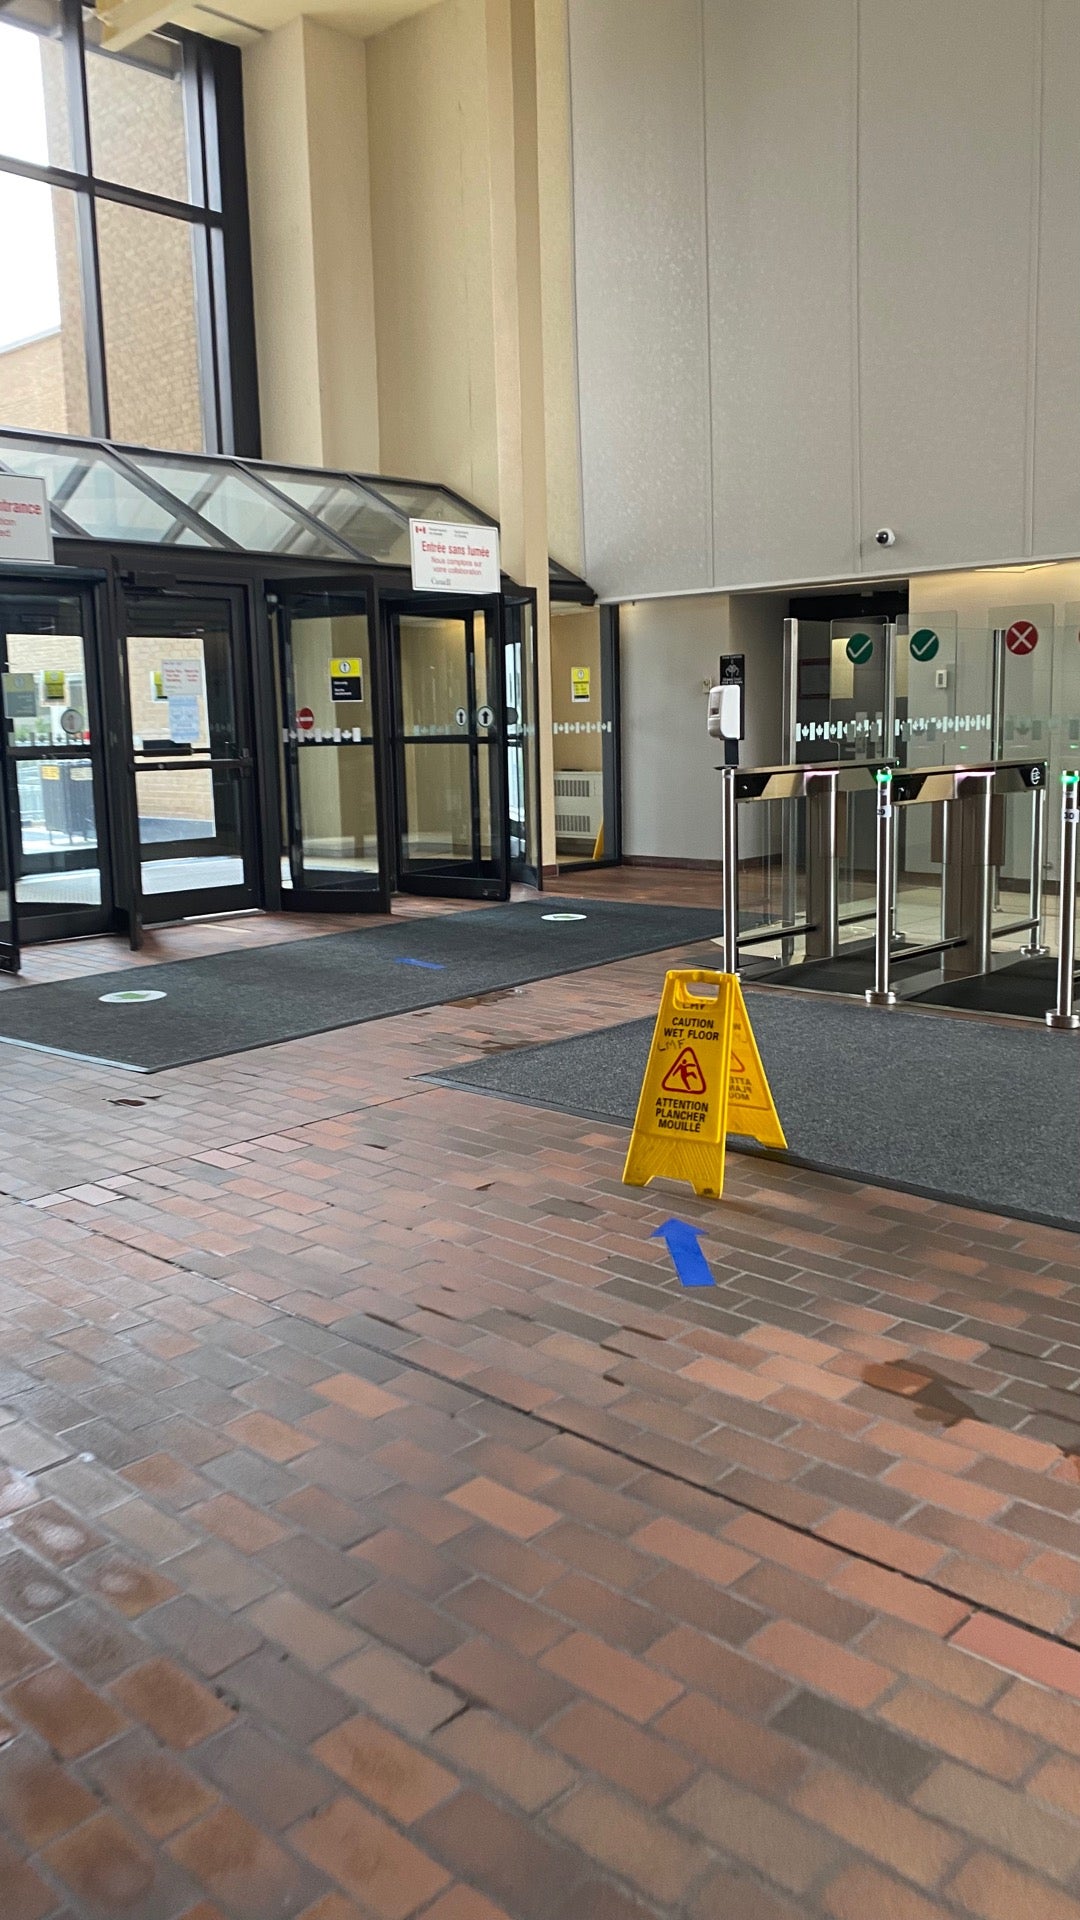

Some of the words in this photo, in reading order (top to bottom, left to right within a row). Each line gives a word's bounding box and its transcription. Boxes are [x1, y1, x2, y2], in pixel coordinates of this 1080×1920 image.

[422, 540, 446, 553] Entrée
[448, 545, 465, 555] sans
[467, 544, 490, 557] fumée
[1064, 811, 1075, 820] 30
[672, 1016, 714, 1029] CAUTION
[664, 1027, 685, 1038] WET
[687, 1029, 719, 1041] FLOOR
[655, 1097, 708, 1113] ATTENTION
[655, 1107, 705, 1123] PLANCHER
[658, 1118, 701, 1133] MOUILLÉ
